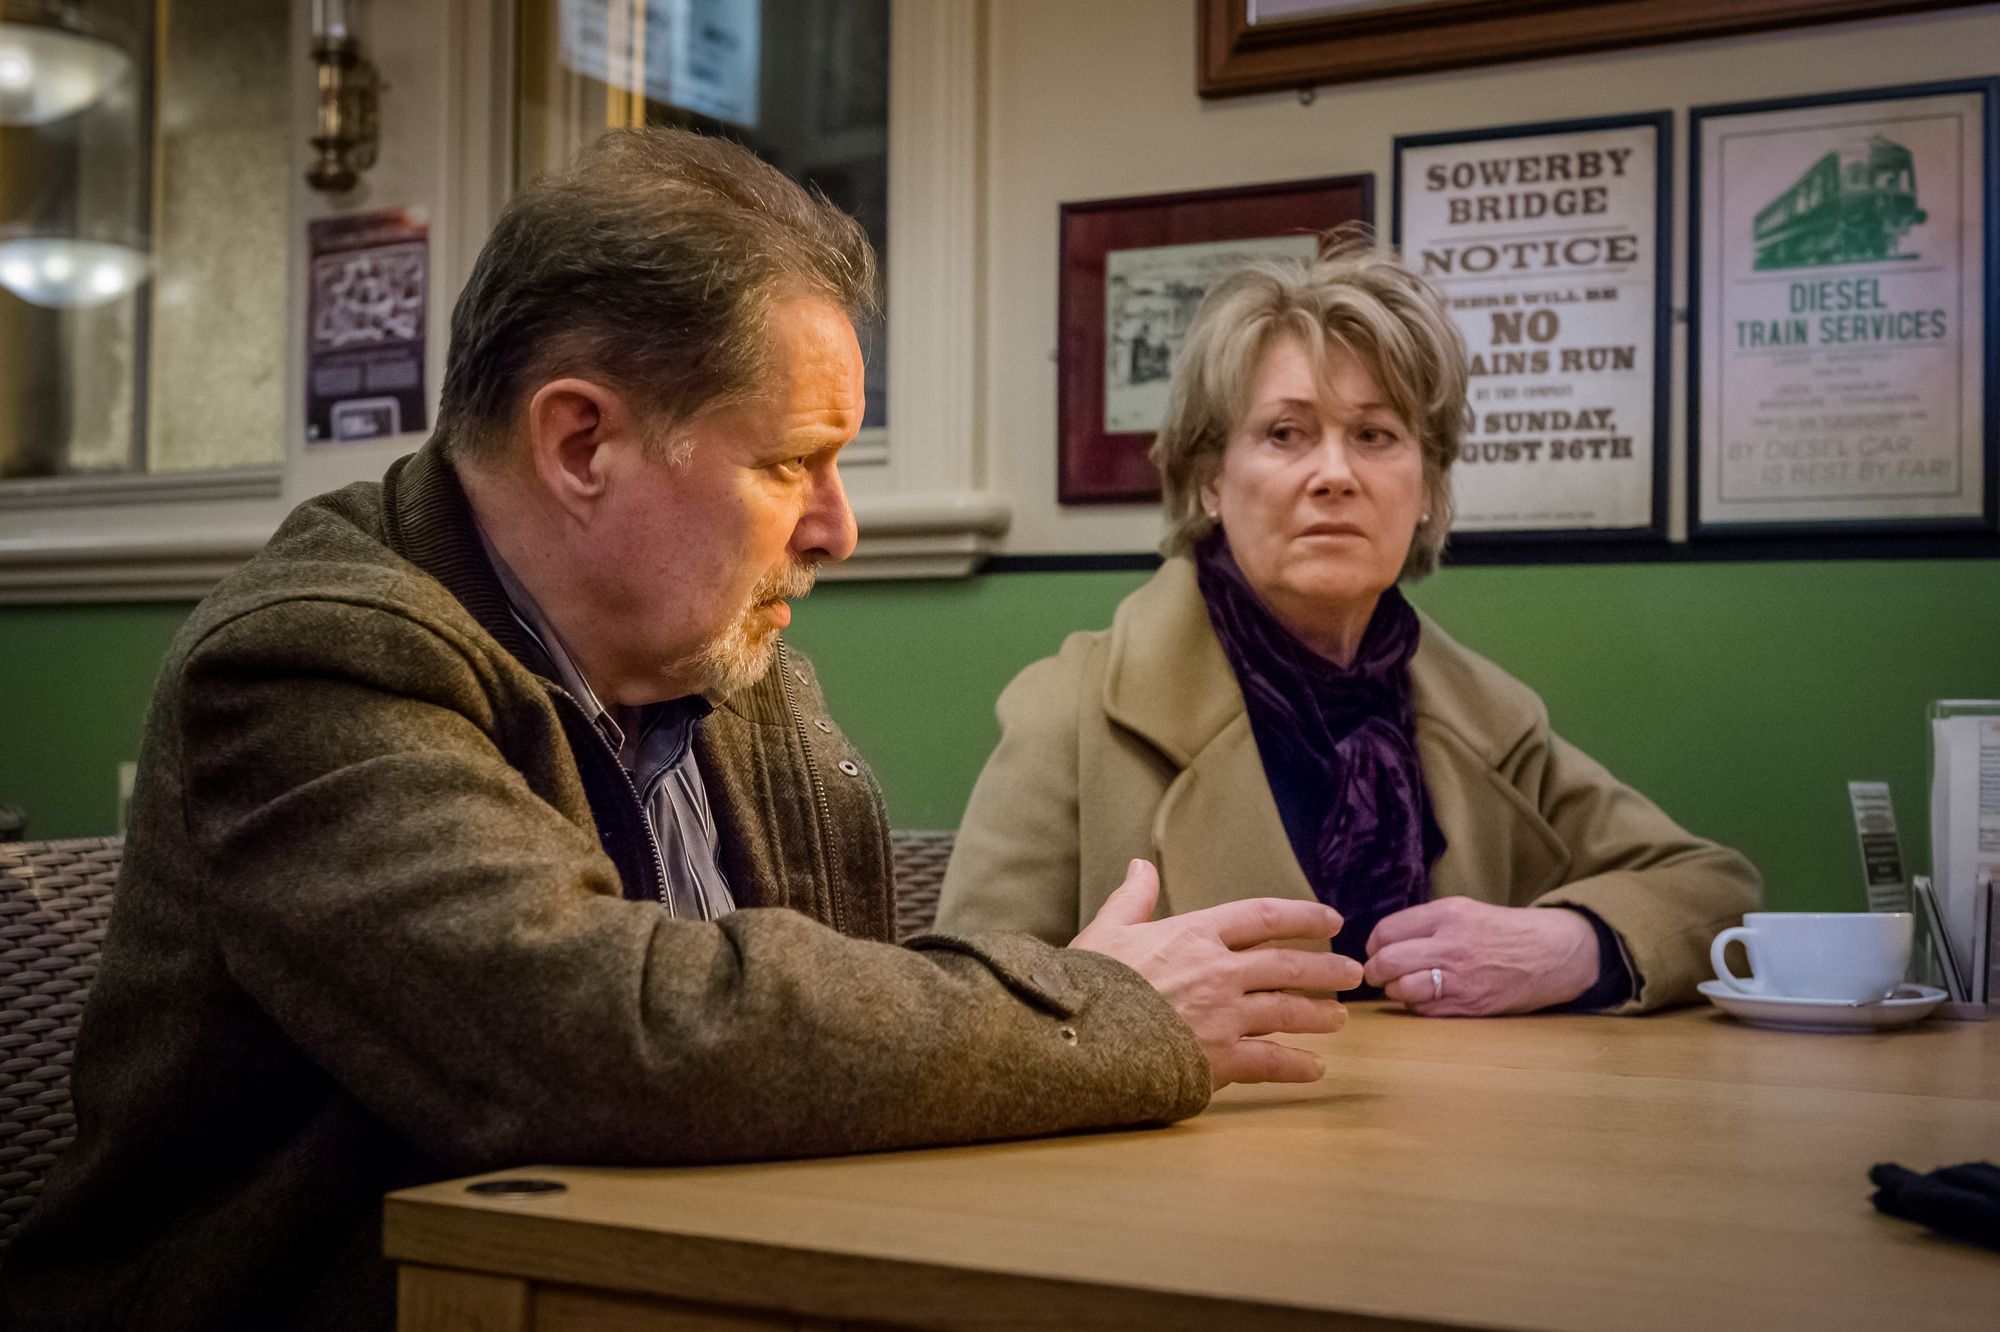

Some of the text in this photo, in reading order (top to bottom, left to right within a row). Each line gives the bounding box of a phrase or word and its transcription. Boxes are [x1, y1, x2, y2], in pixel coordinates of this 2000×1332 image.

[1426, 148, 1632, 192] SOWERBY
[1447, 186, 1608, 224] BRIDGE
[1421, 234, 1638, 276] NOTICE
[1453, 286, 1618, 309] HERE WILL BE
[1789, 277, 1888, 314] DIESEL
[1490, 308, 1560, 346] NO
[1735, 309, 1947, 348] TRAIN SERVICES
[1468, 345, 1635, 377] AINS RUN
[1484, 407, 1616, 433] SUNDAY,
[1460, 436, 1634, 463] GUST 26TH
[1857, 434, 1913, 457] CAR
